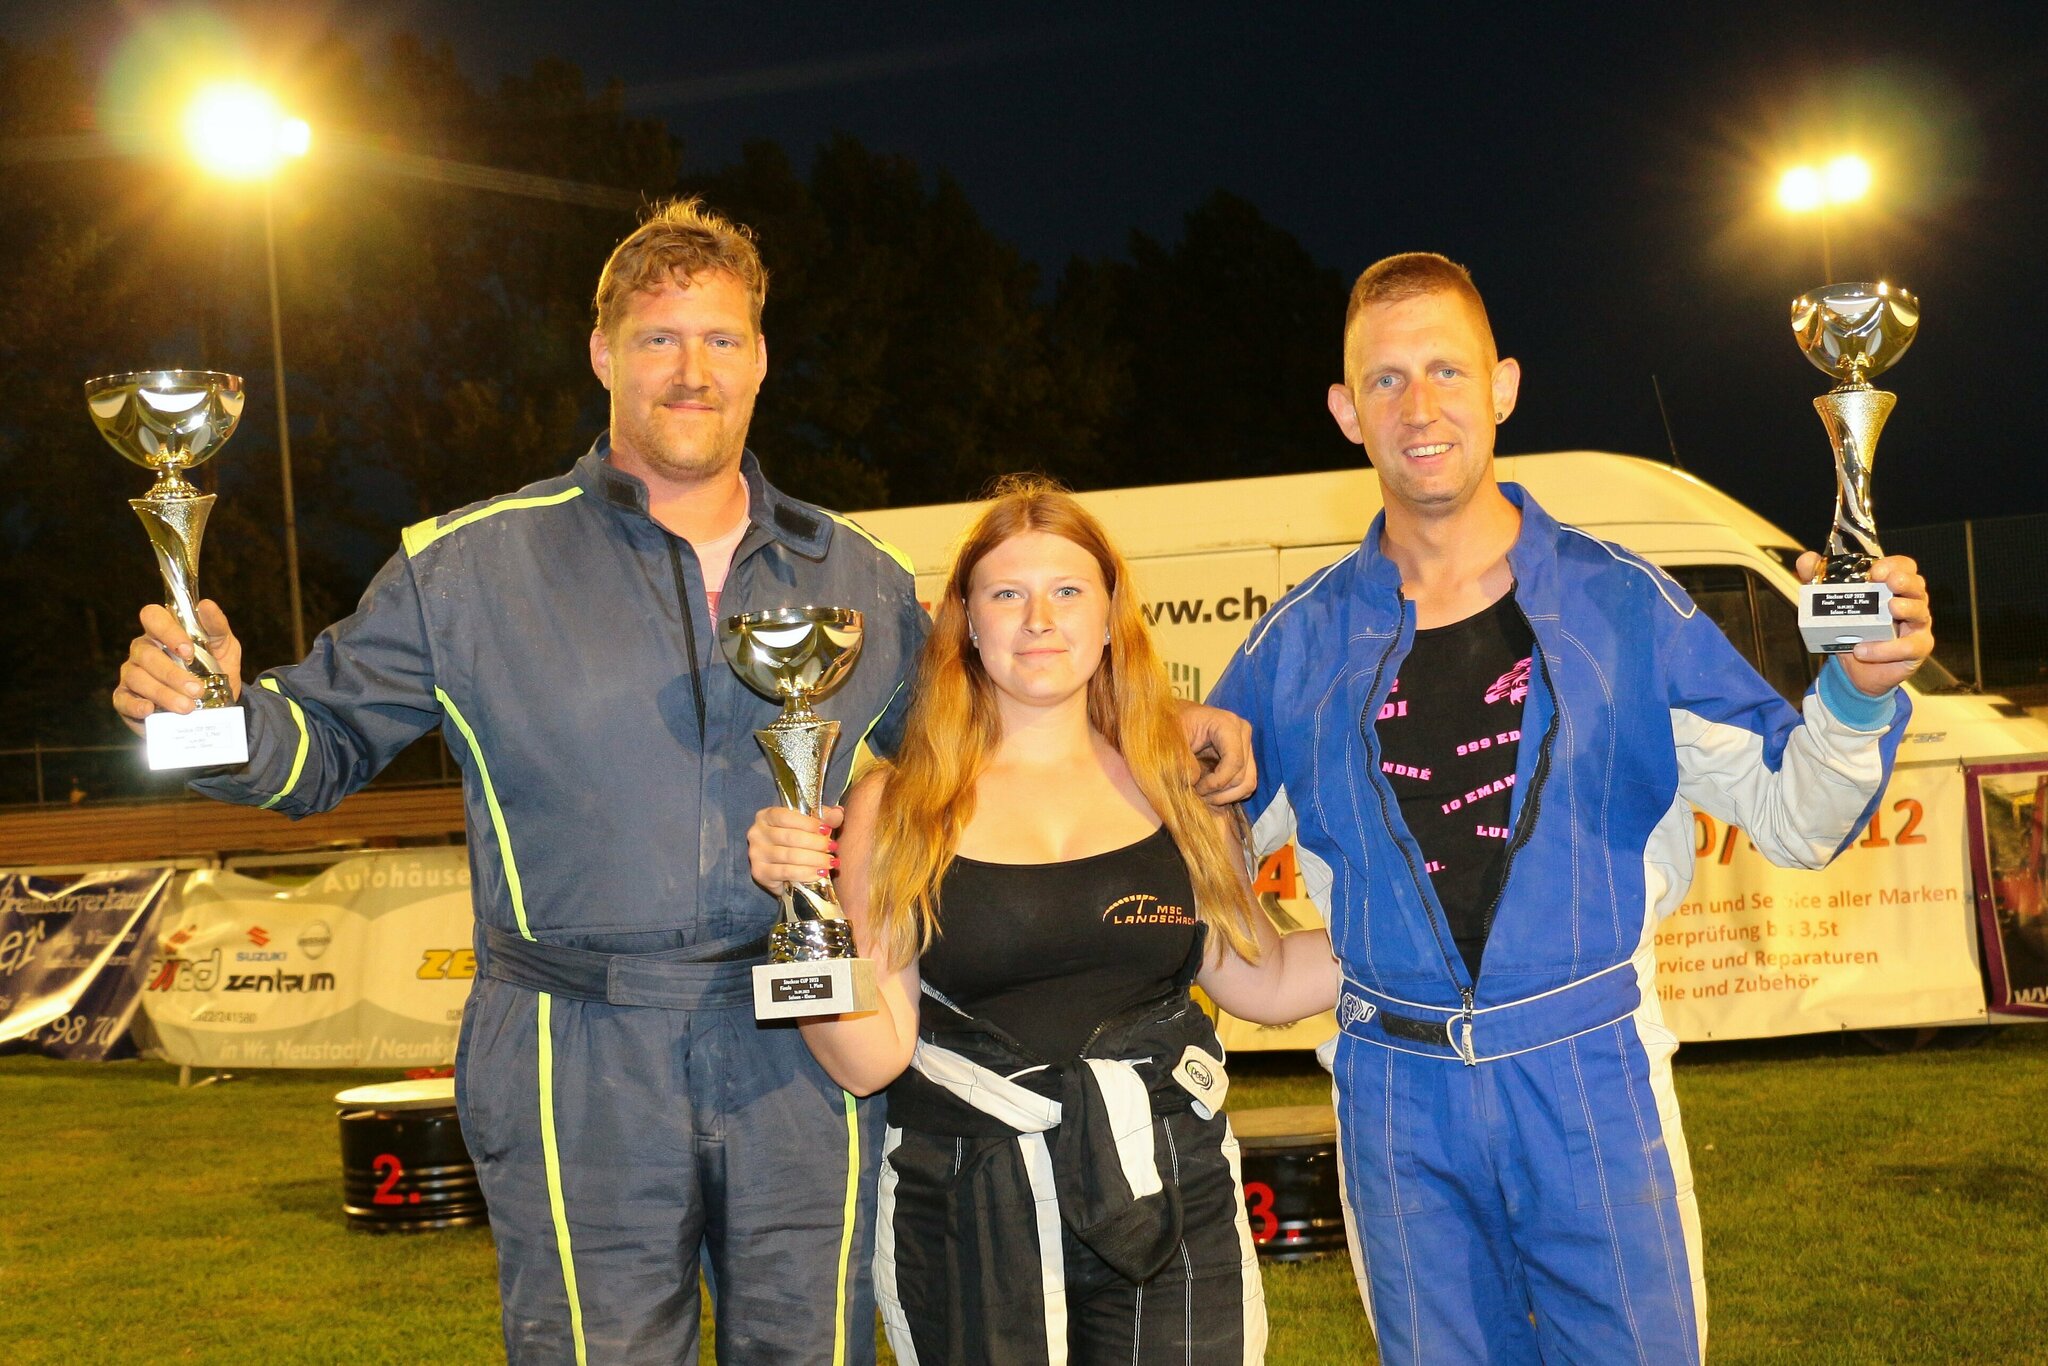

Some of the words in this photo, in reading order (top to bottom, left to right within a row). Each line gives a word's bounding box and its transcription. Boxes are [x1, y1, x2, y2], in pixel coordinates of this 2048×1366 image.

[1456, 737, 1492, 756] 999
[1157, 905, 1183, 915] MSC
[1709, 894, 1746, 914] und
[1827, 890, 1873, 909] aller
[1878, 885, 1958, 906] Marken
[1799, 919, 1839, 940] 3,5t
[235, 951, 287, 962] SUZUKI
[1655, 956, 1705, 975] rvice
[1711, 951, 1748, 970] und
[1754, 949, 1879, 970] Reparaturen
[1692, 979, 1729, 1000] und
[1734, 972, 1819, 994] Zubehör
[44, 1014, 88, 1047] 98
[372, 1153, 422, 1206] 2.
[1244, 1181, 1300, 1244] 3.
